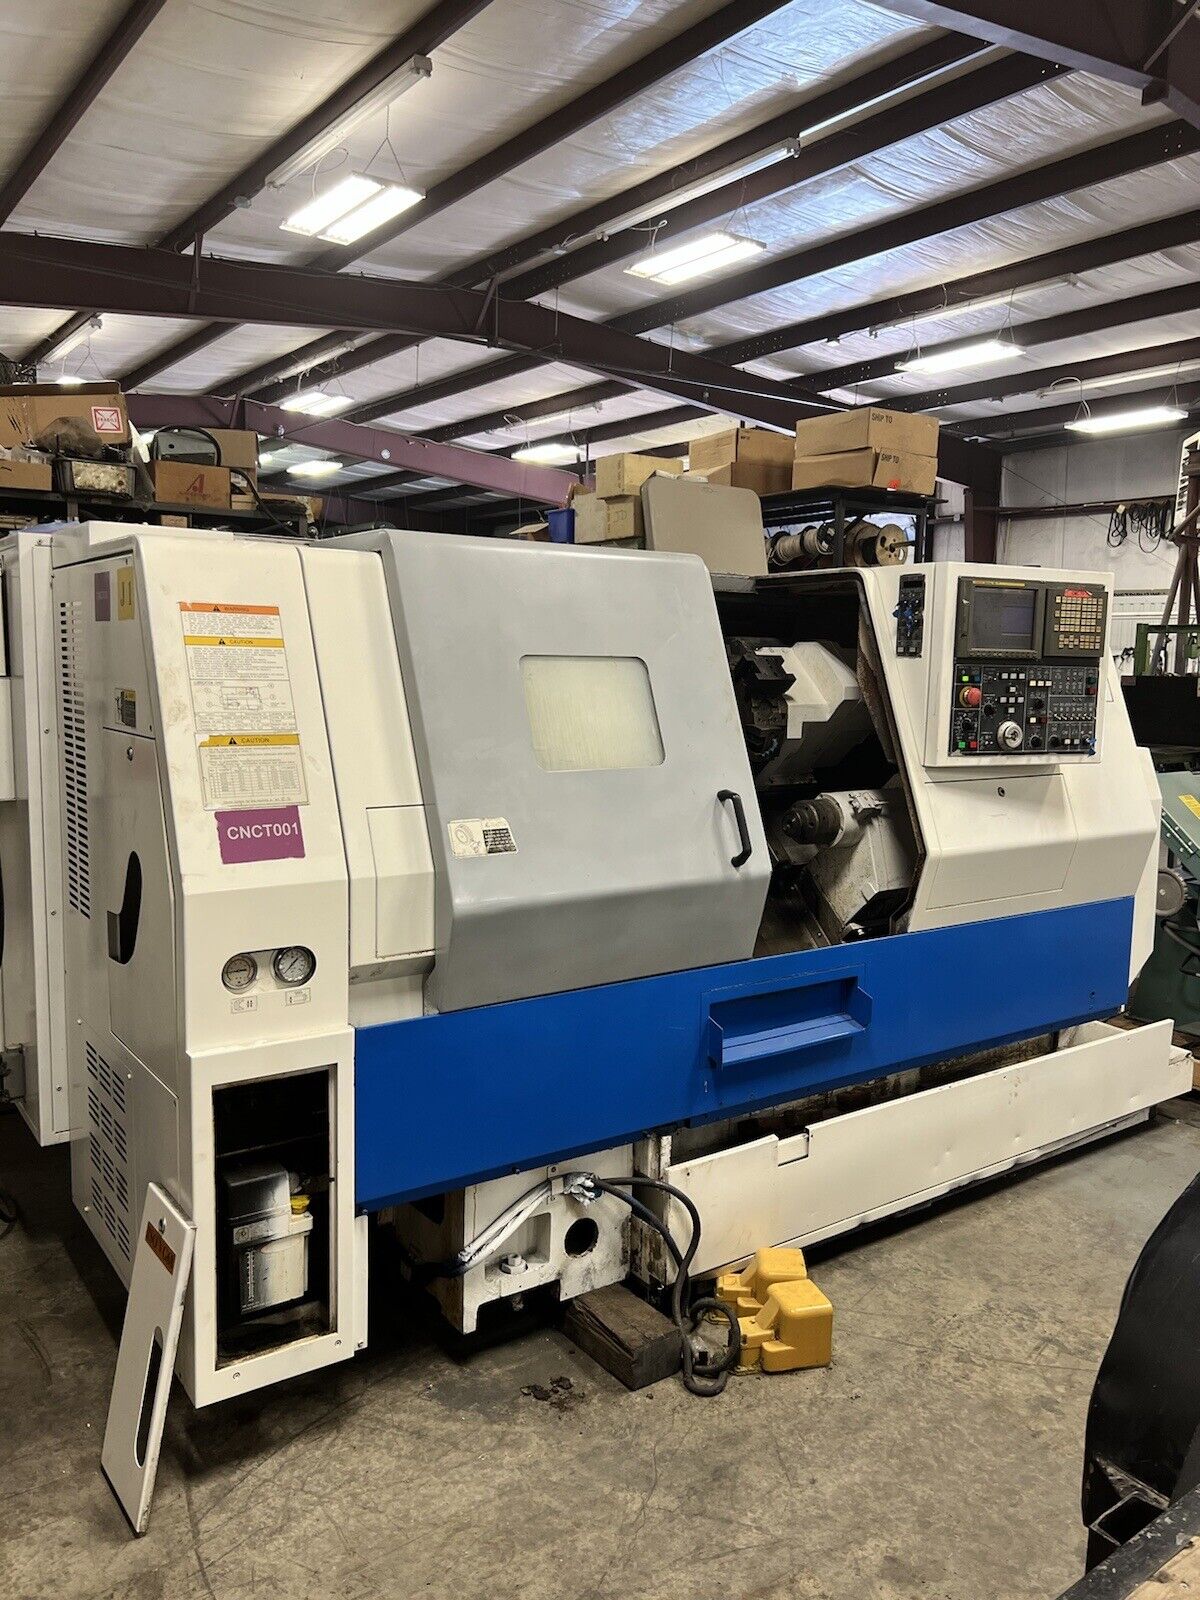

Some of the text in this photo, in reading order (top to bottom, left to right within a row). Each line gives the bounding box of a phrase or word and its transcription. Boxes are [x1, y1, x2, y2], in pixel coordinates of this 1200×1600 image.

[872, 412, 893, 424] SHIP TO
[881, 453, 900, 464] SHIP TO
[227, 822, 299, 840] CNCT001
